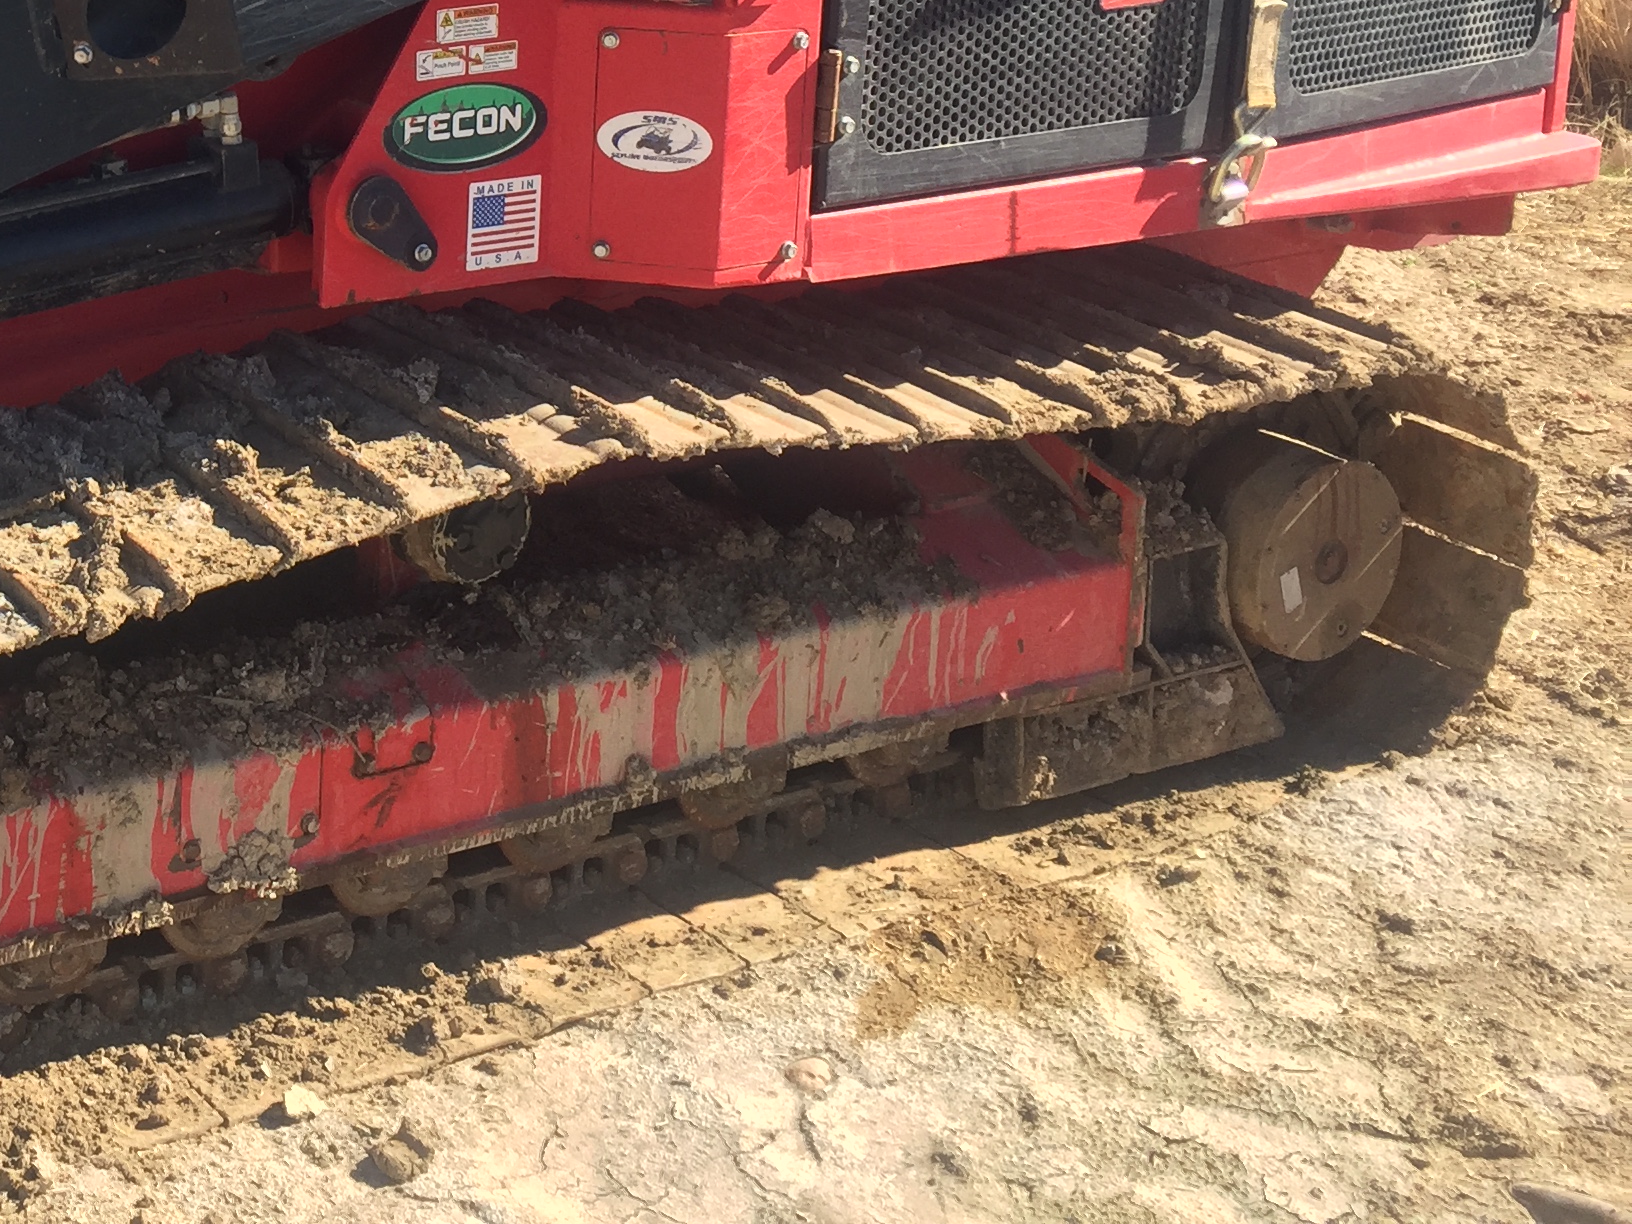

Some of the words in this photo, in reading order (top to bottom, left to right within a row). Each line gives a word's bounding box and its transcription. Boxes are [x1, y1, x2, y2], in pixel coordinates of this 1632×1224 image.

[403, 103, 522, 145] FECON
[475, 182, 514, 195] MADE
[521, 179, 534, 190] IN
